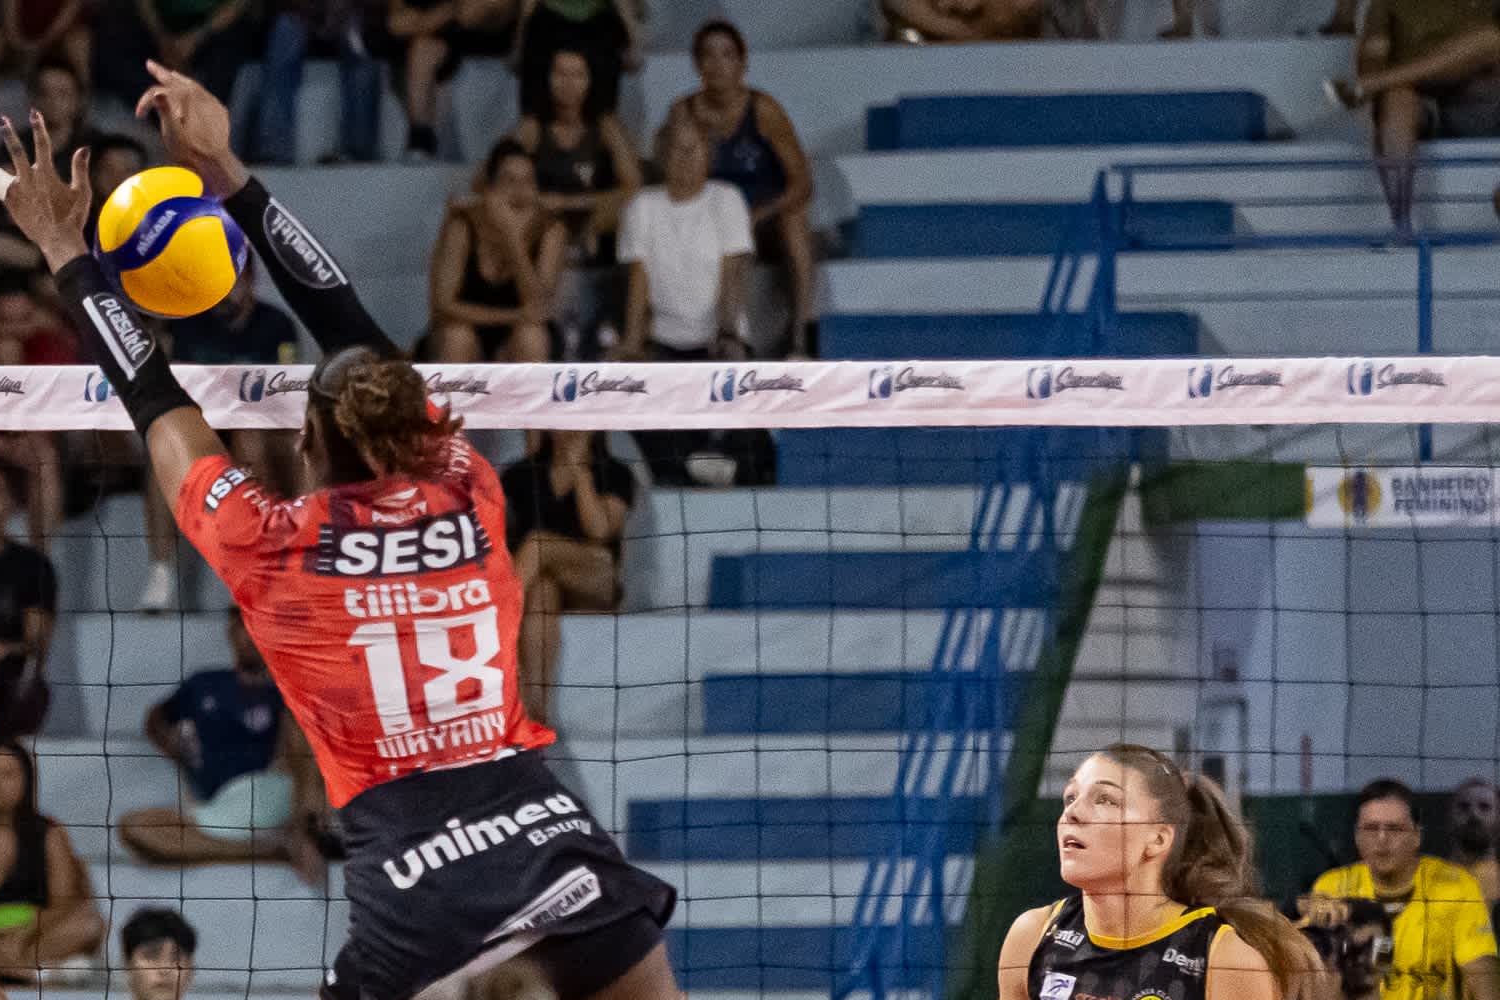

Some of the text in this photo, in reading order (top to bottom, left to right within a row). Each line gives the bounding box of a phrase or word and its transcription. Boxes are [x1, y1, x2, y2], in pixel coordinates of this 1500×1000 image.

[334, 514, 477, 576] SESI
[344, 579, 492, 618] tilibra
[347, 606, 505, 736] 18
